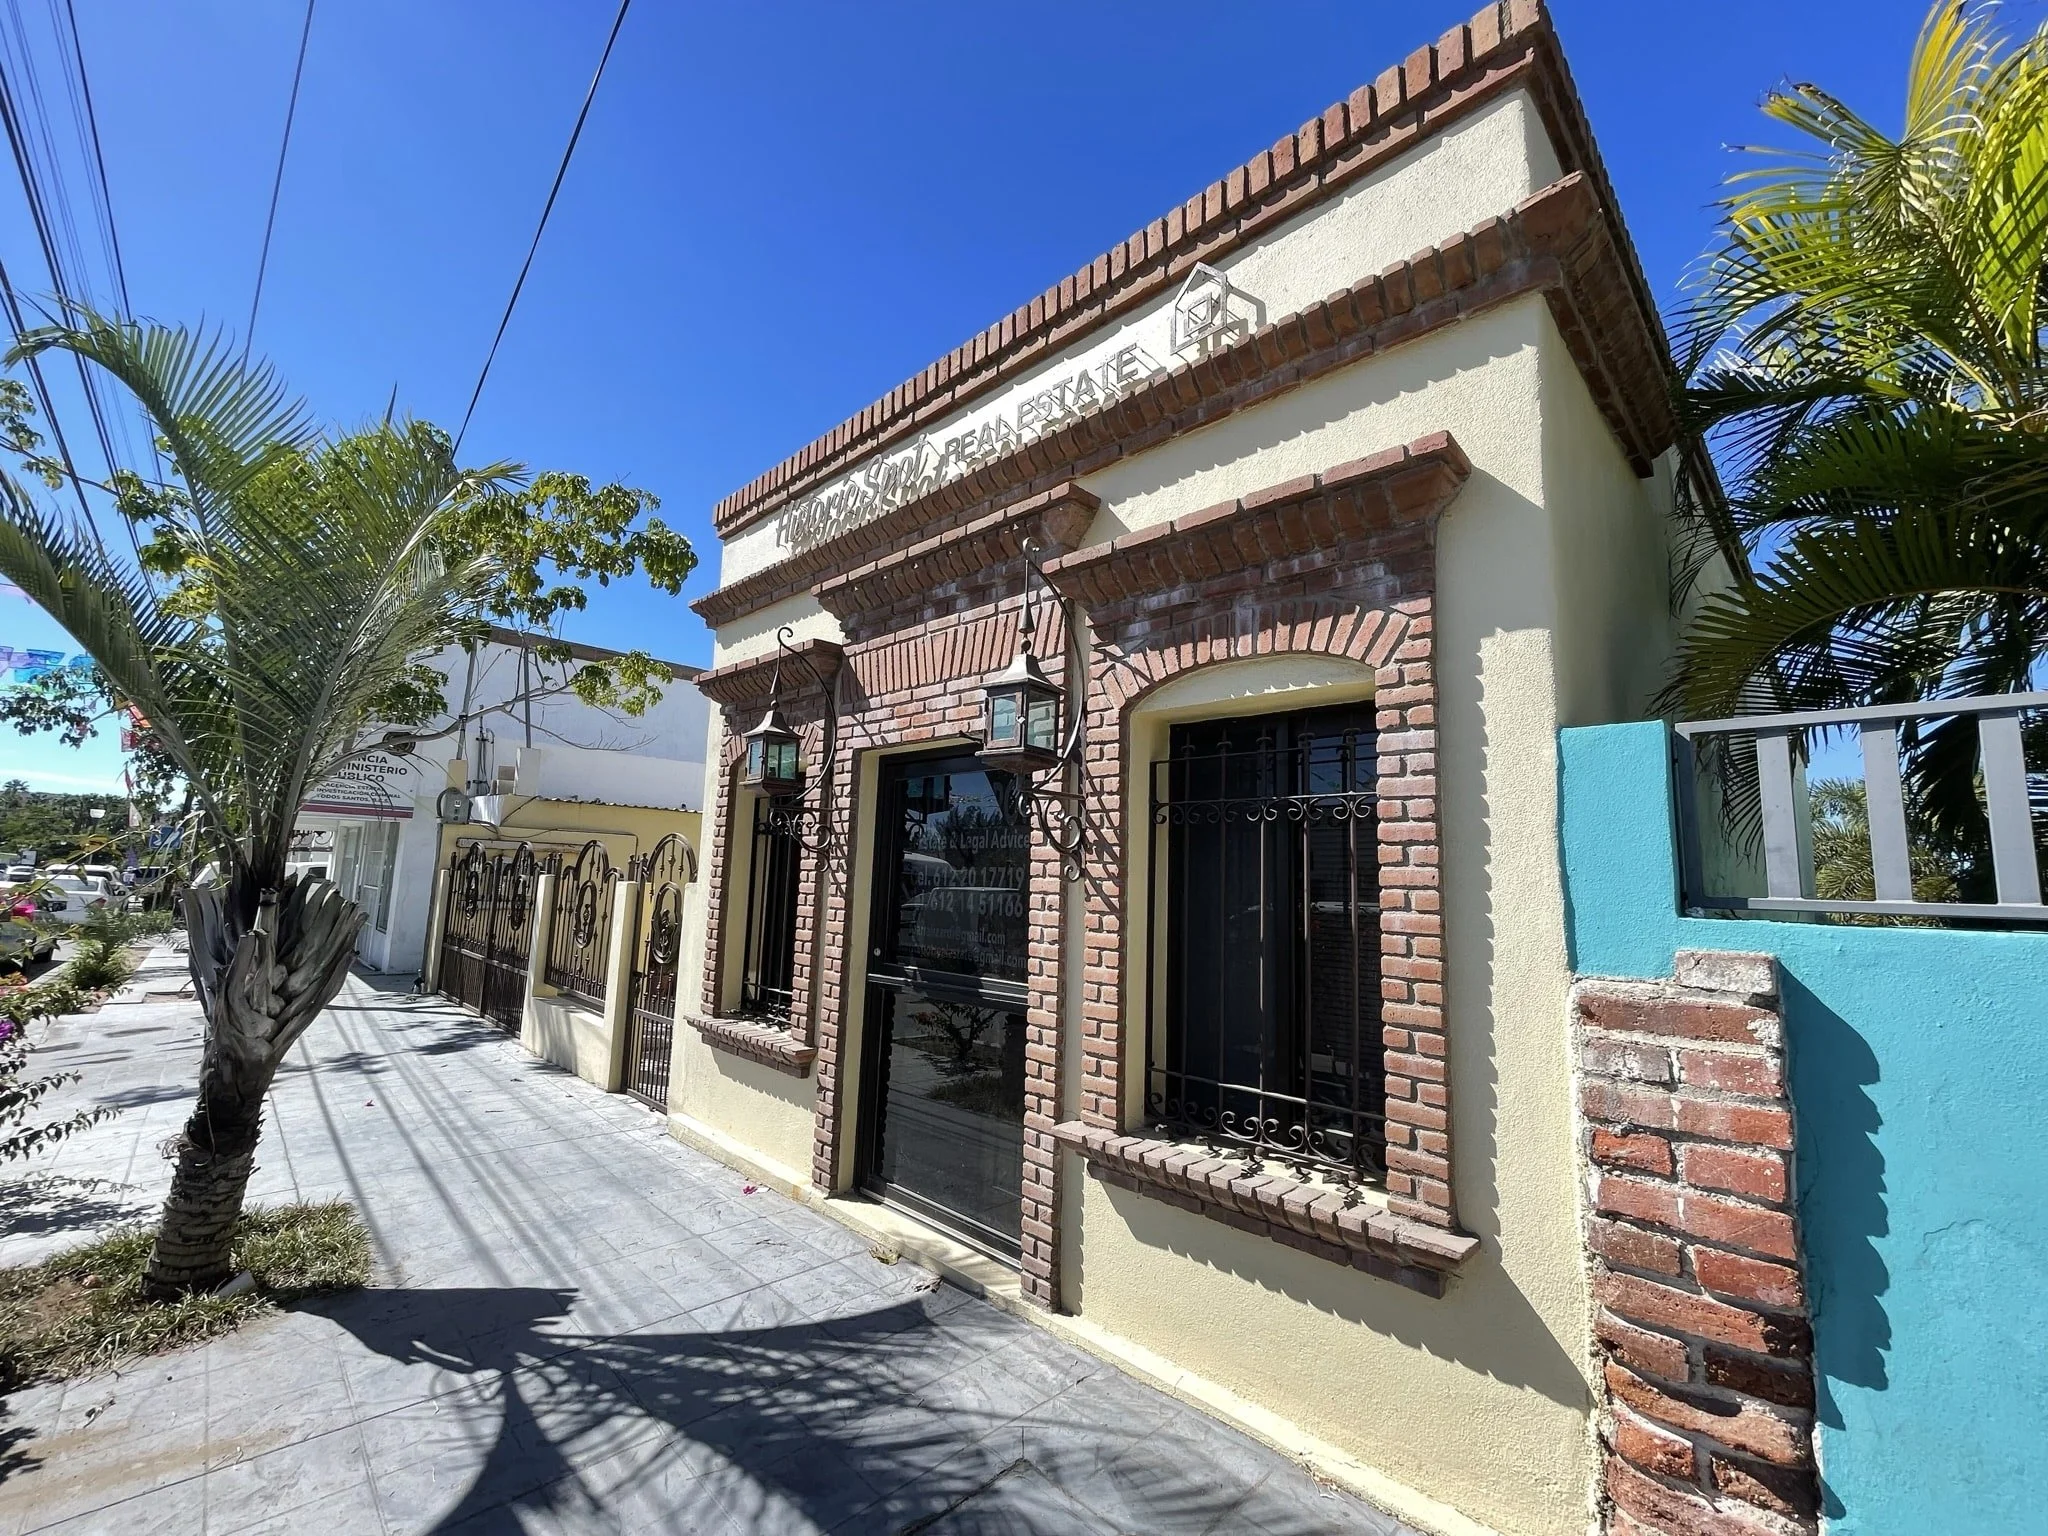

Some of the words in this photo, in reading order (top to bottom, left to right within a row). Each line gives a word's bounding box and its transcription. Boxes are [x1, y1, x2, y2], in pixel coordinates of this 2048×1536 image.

[776, 473, 859, 547] Historic
[859, 433, 929, 516] Spot
[944, 413, 1010, 467] REAL
[1017, 343, 1139, 431] ESTATE
[960, 829, 989, 855] Legal
[990, 829, 1030, 850] Advice
[980, 866, 1026, 890] 17719
